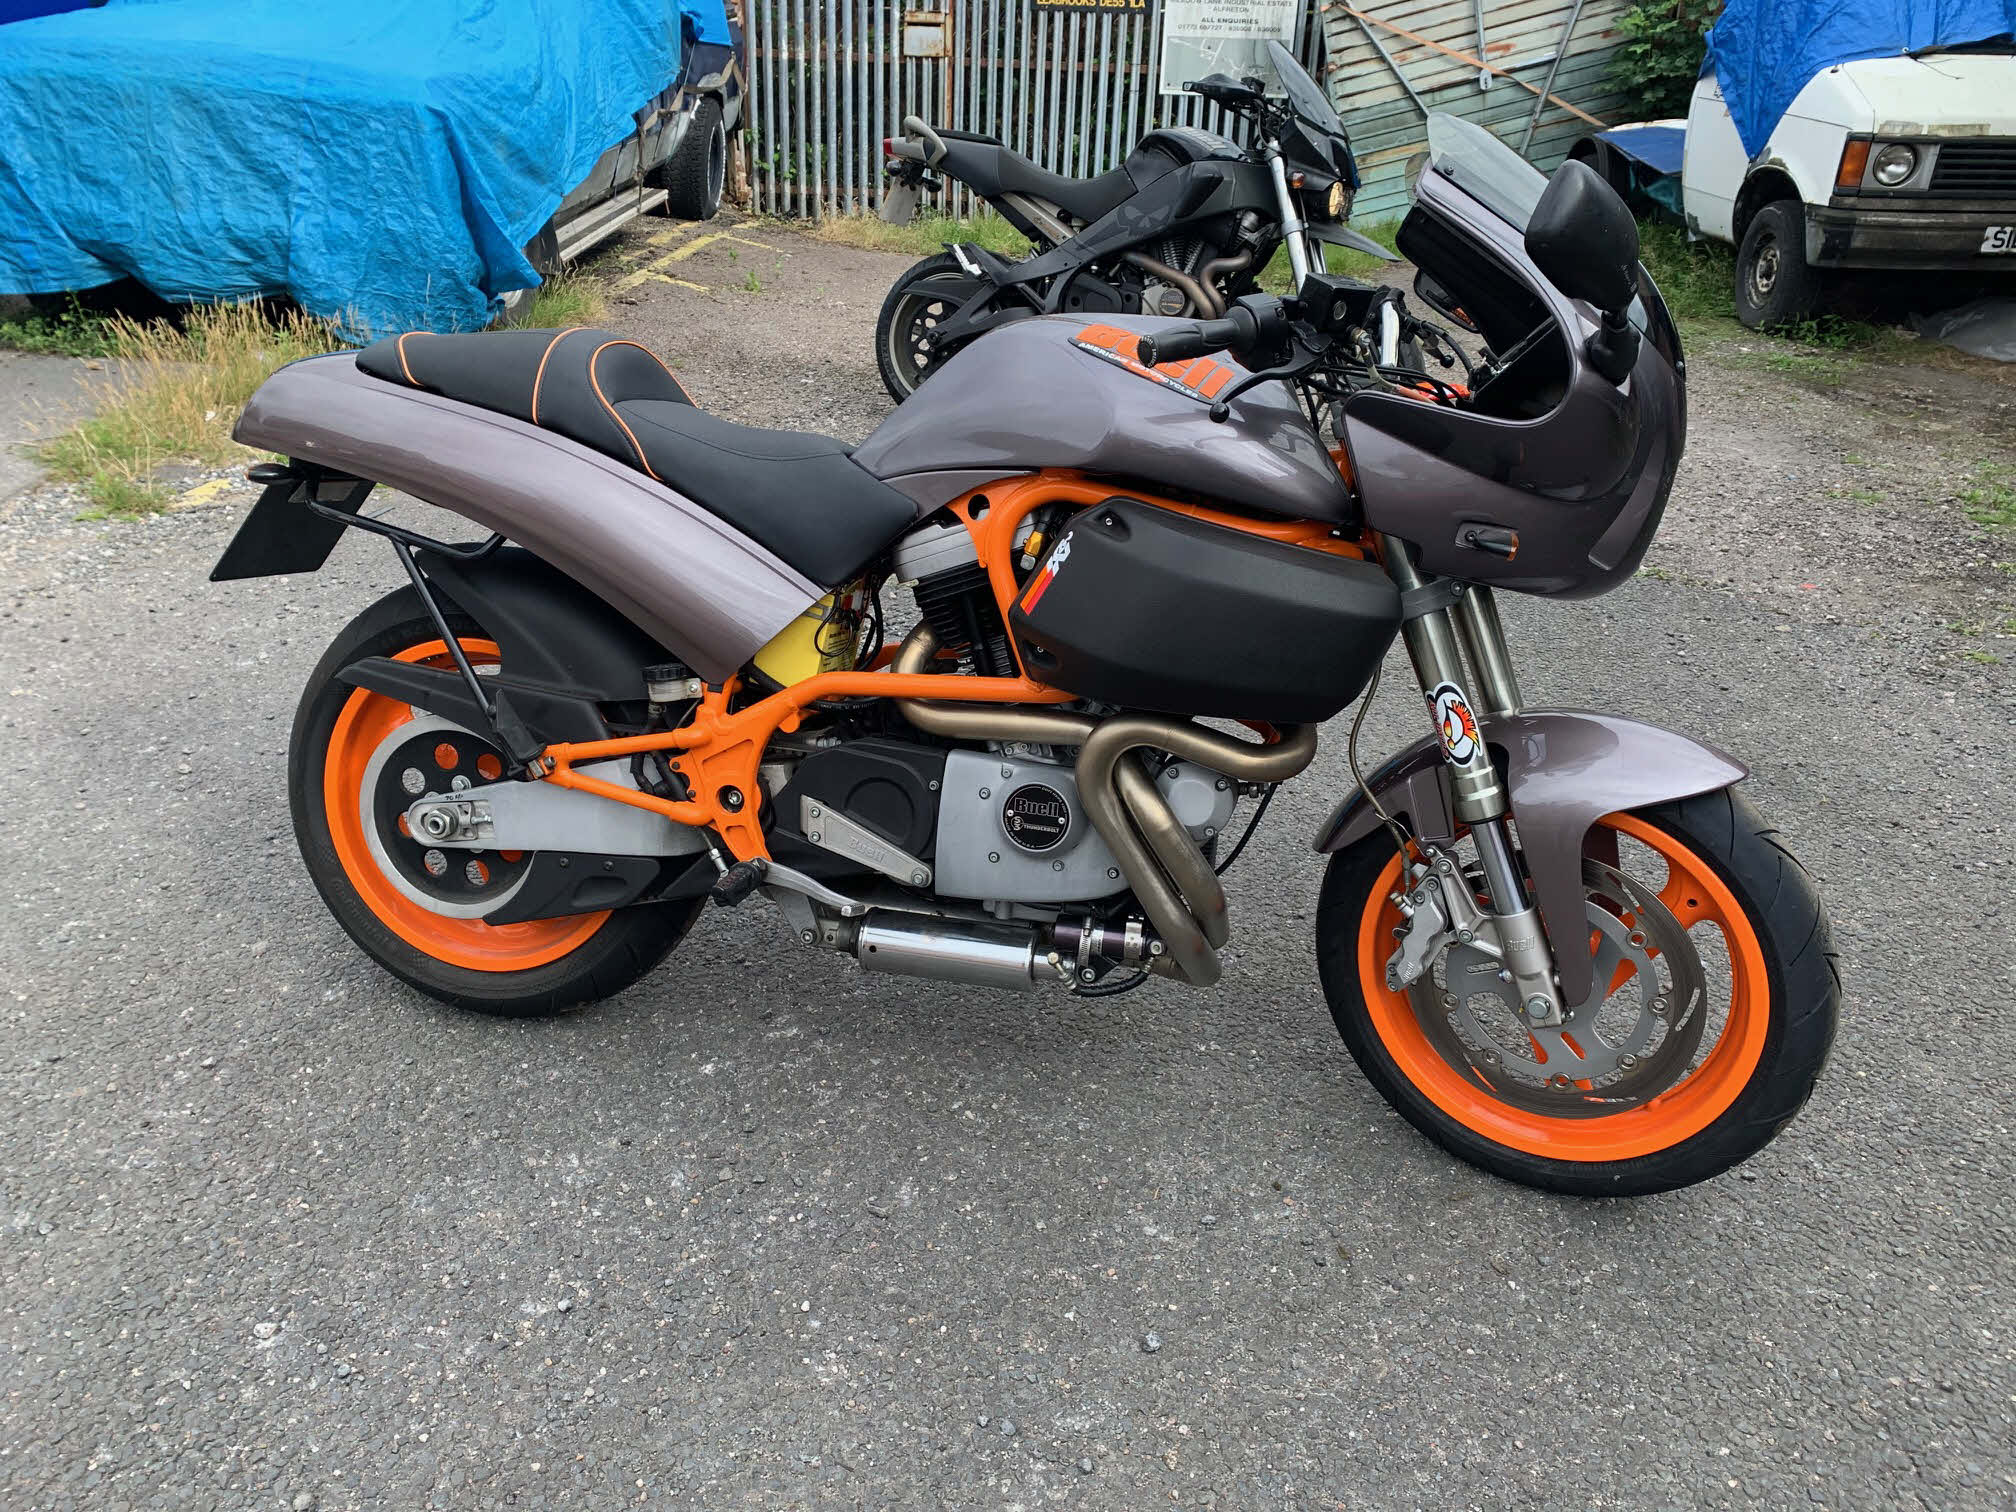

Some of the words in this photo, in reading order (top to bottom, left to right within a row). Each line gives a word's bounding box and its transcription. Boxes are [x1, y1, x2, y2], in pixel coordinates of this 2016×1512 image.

[1078, 342, 1129, 363] AMERICAN
[1130, 361, 1199, 398] MOTORCYCLES
[1014, 797, 1060, 818] Buell
[1023, 823, 1060, 834] THUNDERBOLT
[847, 836, 887, 863] Buell
[1504, 935, 1535, 953] Buell
